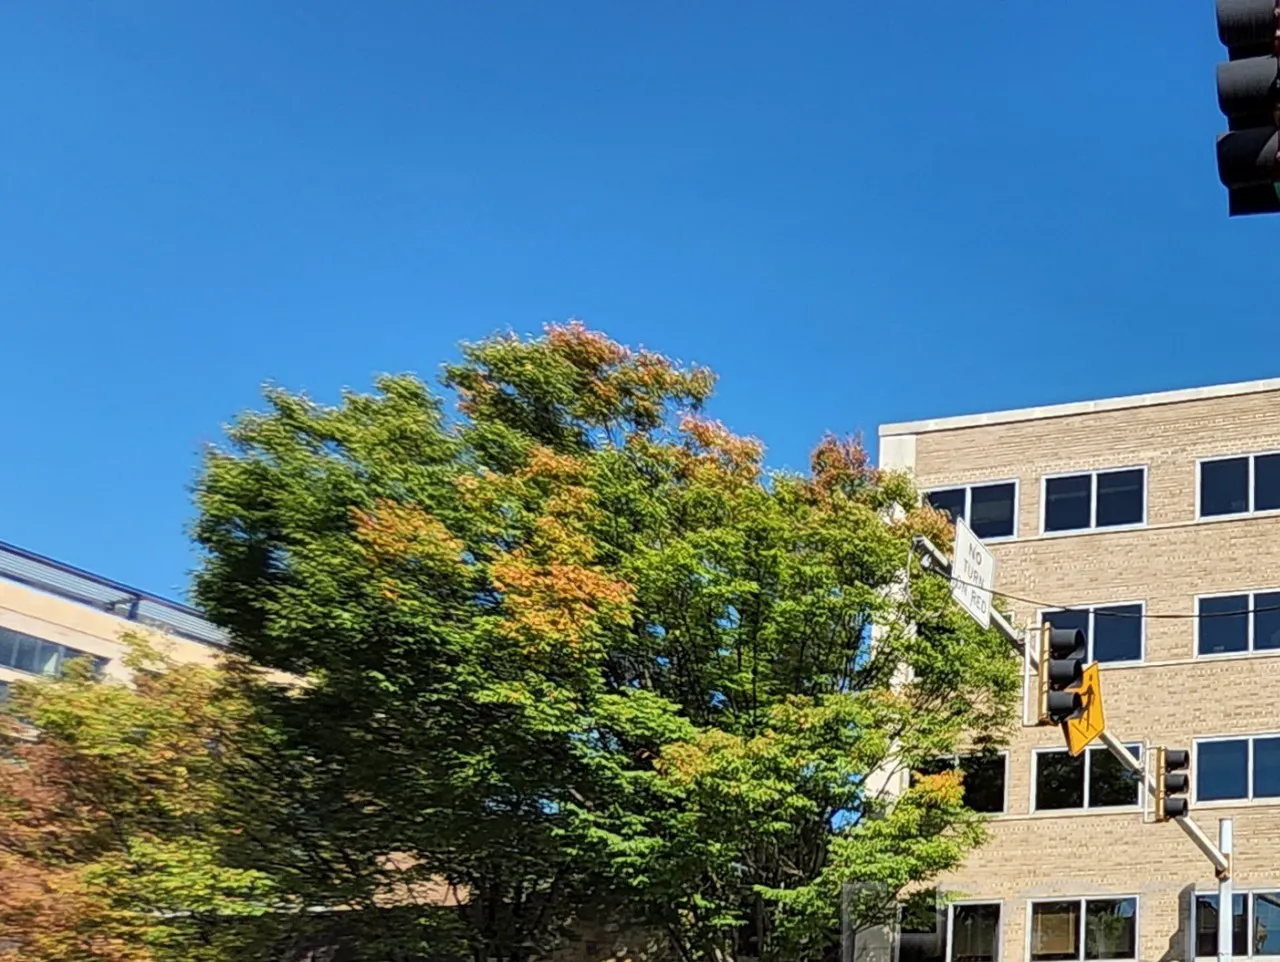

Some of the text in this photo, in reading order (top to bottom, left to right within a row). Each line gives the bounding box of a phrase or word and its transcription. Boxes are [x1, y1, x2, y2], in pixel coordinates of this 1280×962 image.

[968, 543, 982, 566] NO
[963, 558, 985, 589] TURN
[953, 576, 987, 614] ON RED
